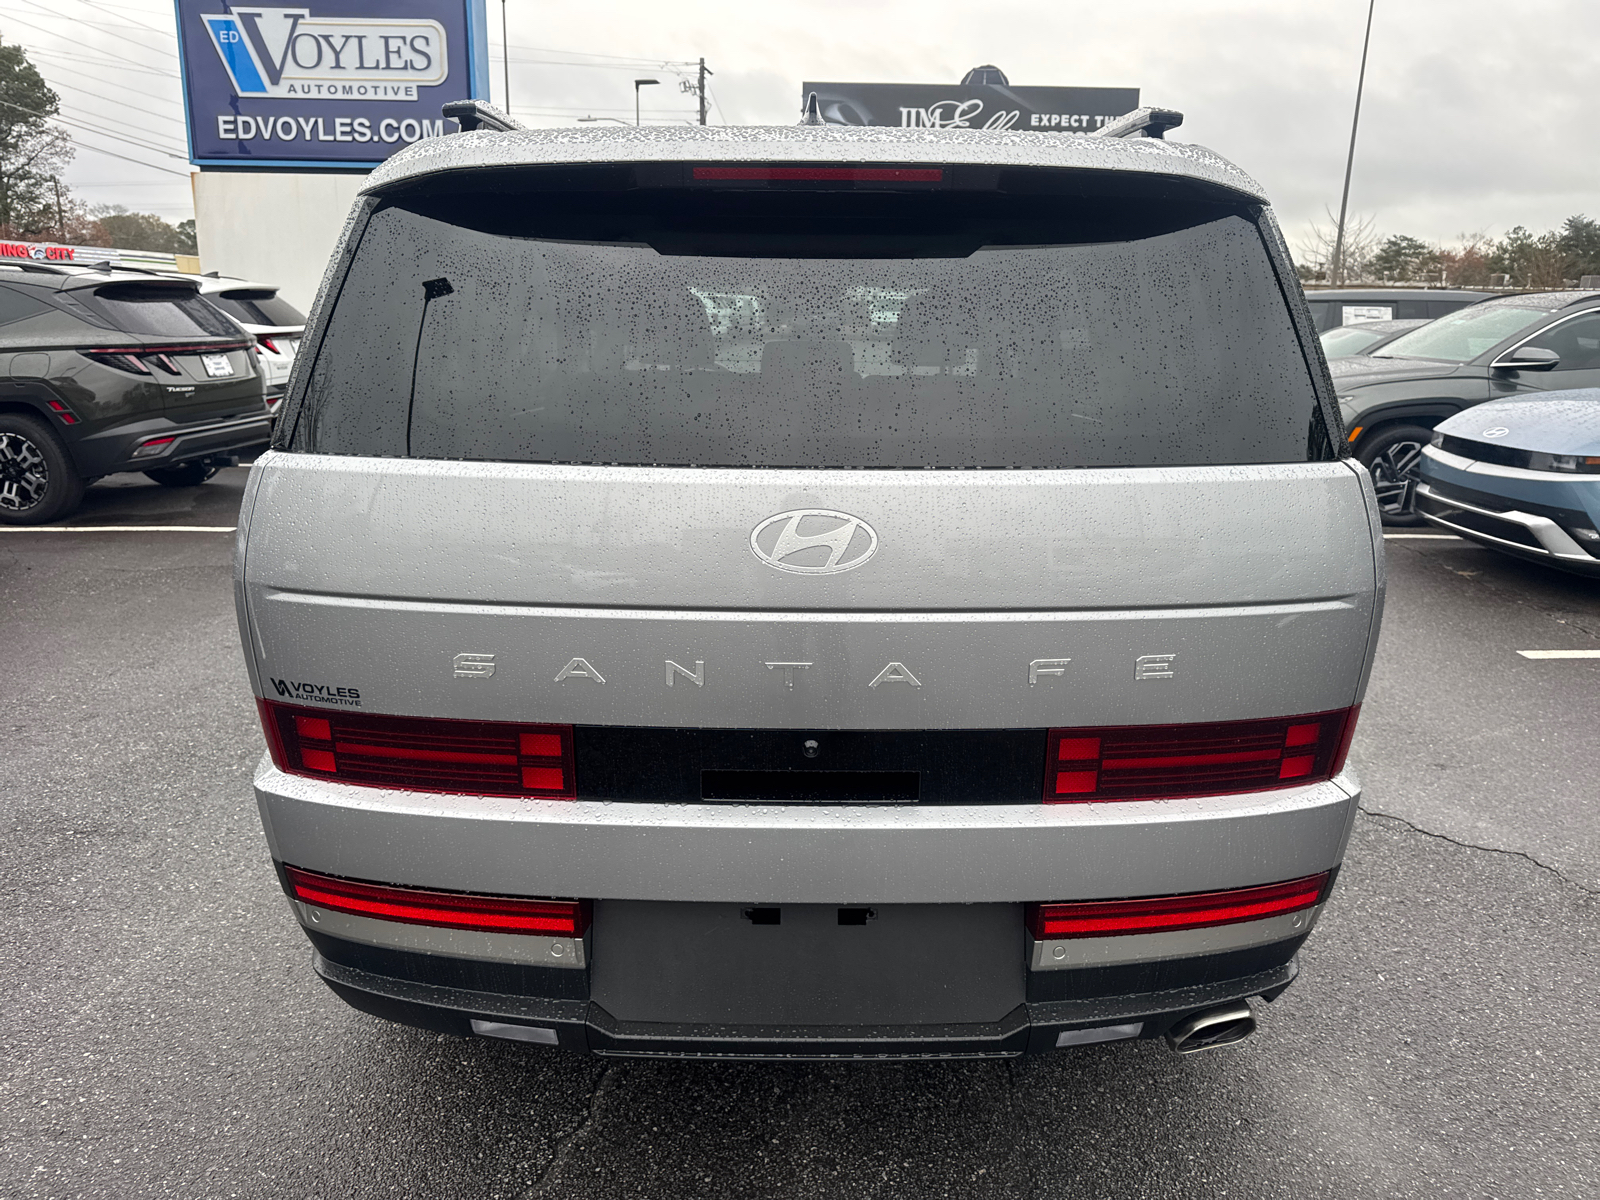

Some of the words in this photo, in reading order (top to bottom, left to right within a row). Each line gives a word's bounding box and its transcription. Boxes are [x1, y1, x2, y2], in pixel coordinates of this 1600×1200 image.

[219, 30, 239, 43] ED
[237, 12, 432, 86] VOYLES
[287, 83, 414, 97] AUTOMOTIVE
[217, 115, 444, 143] EDVOYLES.COM
[1030, 114, 1090, 127] EXPECT
[1094, 115, 1122, 127] TH
[0, 243, 28, 258] ING
[46, 246, 75, 260] CITY
[453, 653, 922, 688] SANTA
[1028, 654, 1177, 687] FE
[290, 681, 360, 698] VOYLES
[295, 693, 362, 706] AUTOMOTIVE
